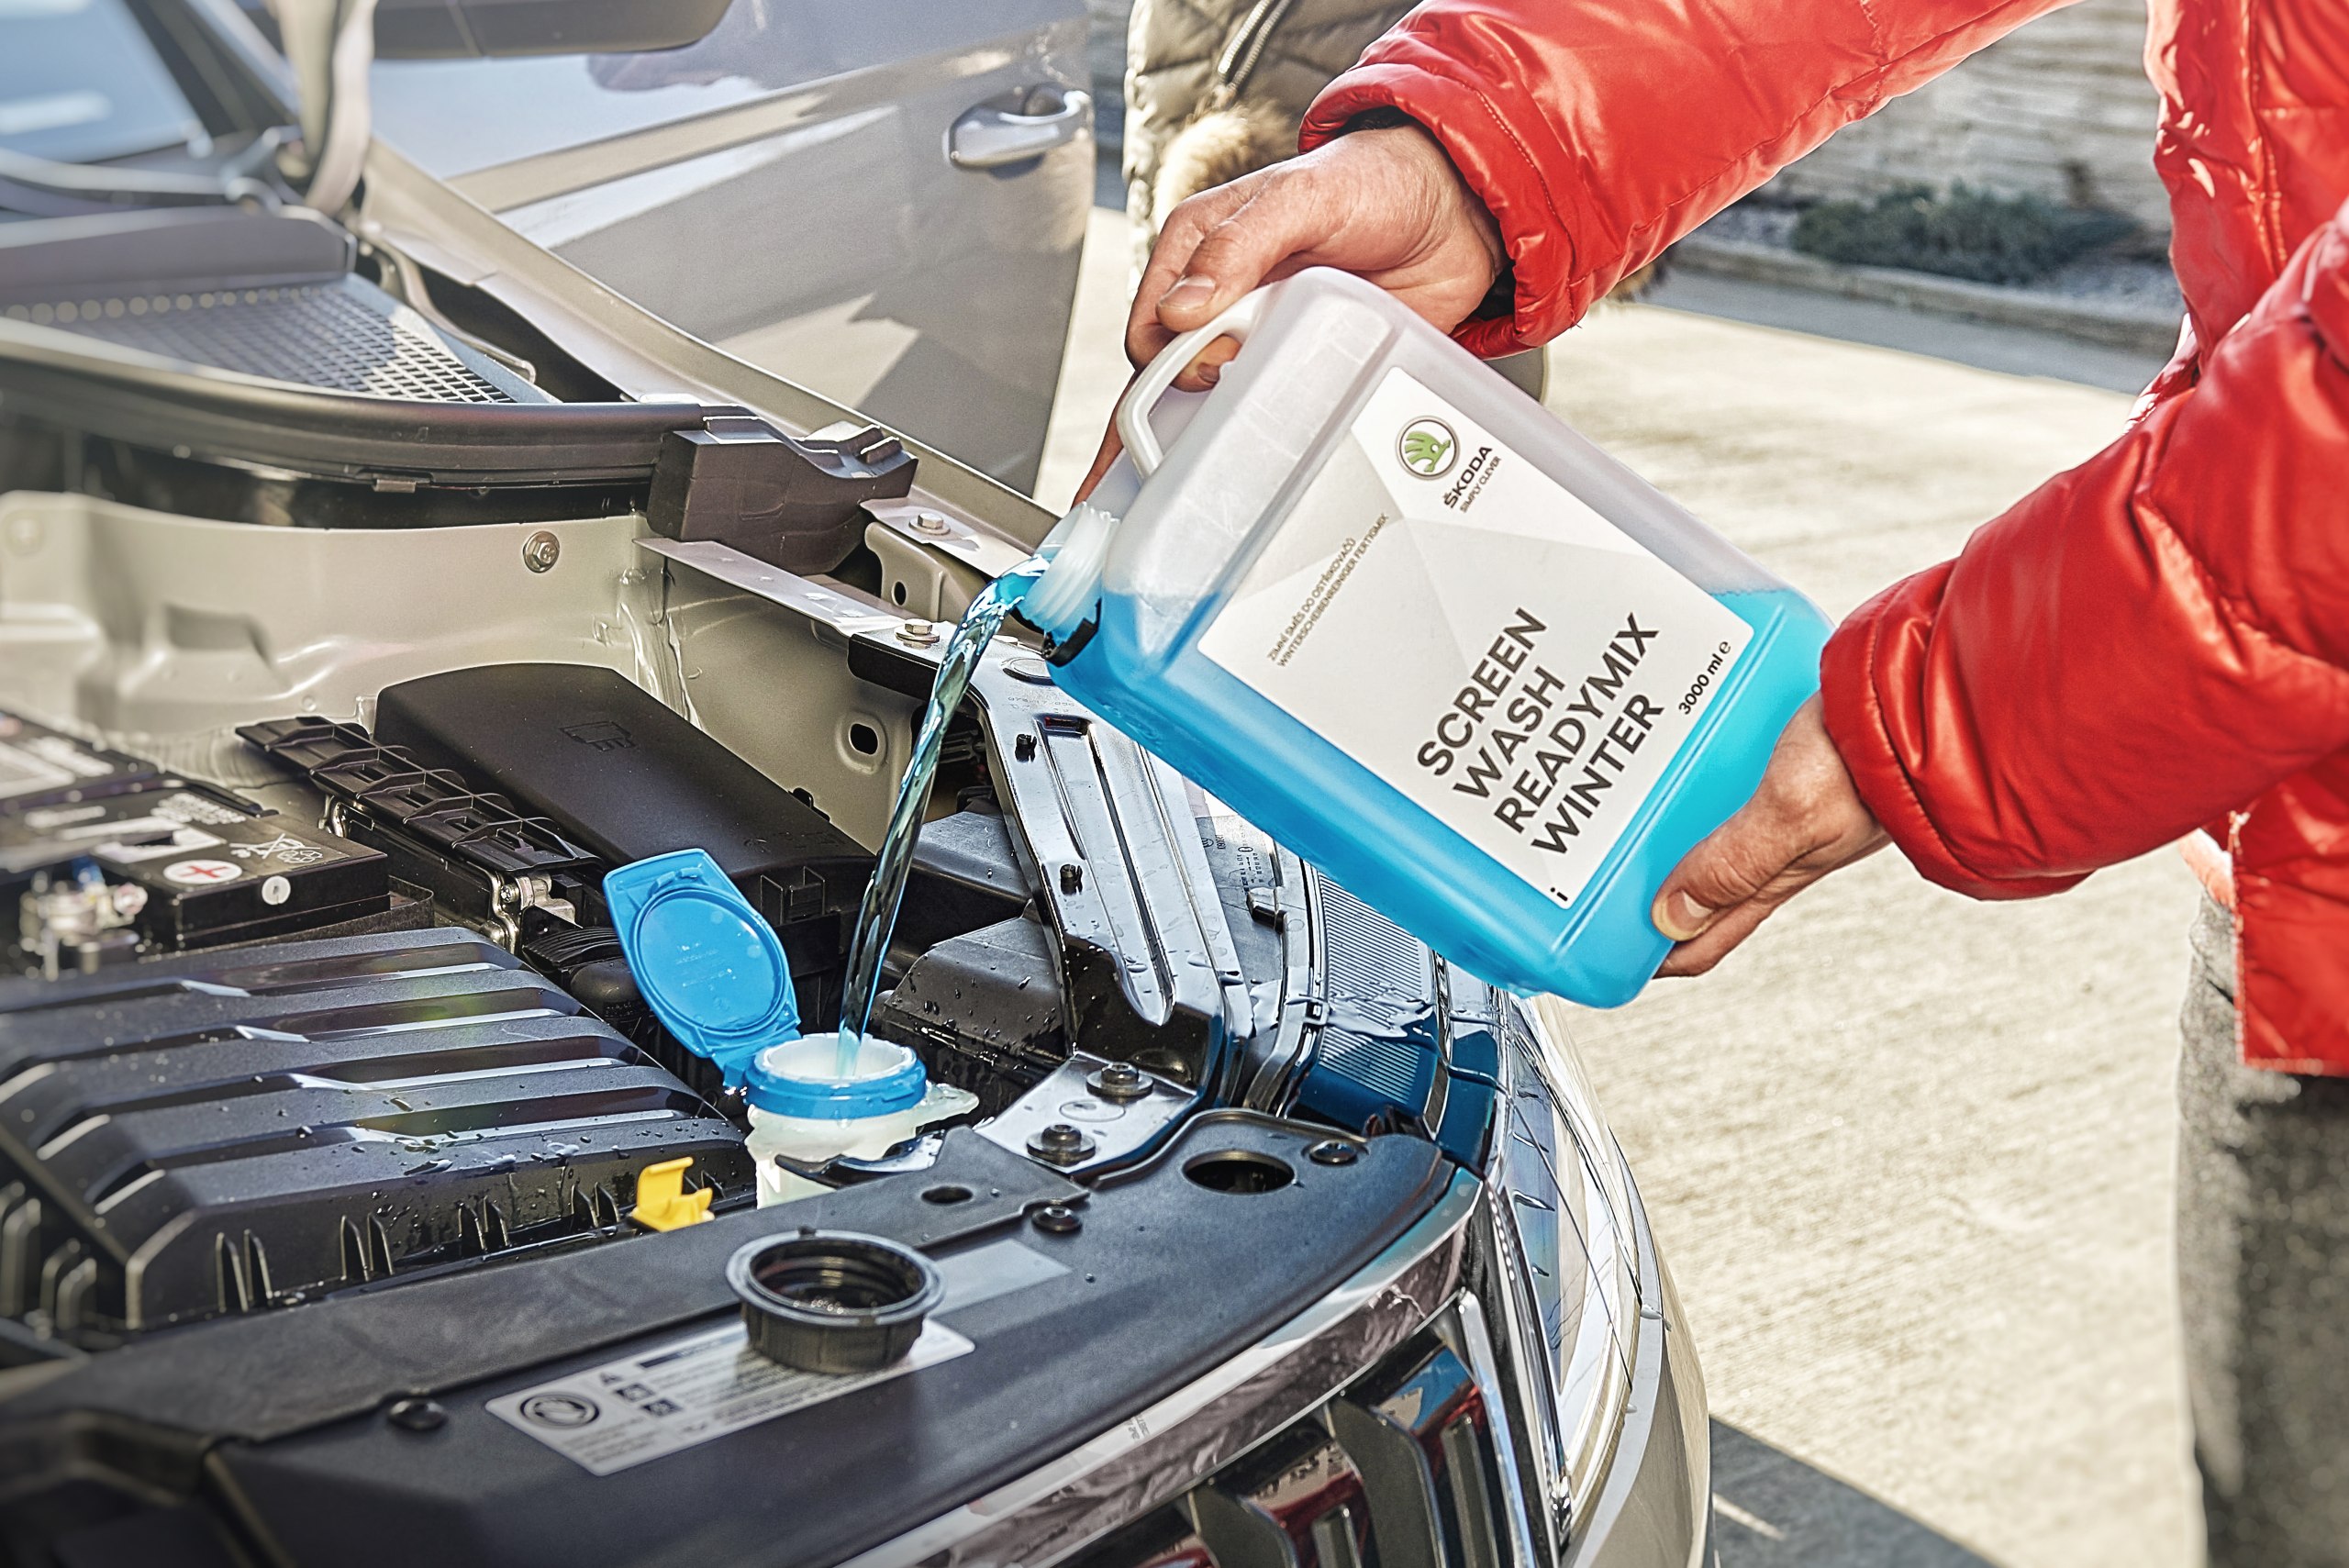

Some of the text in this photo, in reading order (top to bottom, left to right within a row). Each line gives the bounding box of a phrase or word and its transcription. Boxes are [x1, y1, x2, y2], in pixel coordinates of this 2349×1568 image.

[1443, 446, 1493, 508] ŠKODA
[1460, 456, 1501, 513] SIMPLY CLEVER
[1301, 597, 1315, 613] DO
[1417, 607, 1547, 776] SCREEN
[1453, 665, 1566, 799] WASH
[1494, 612, 1659, 834] READYMIX
[1678, 674, 1709, 715] 3000
[1707, 653, 1723, 675] ml
[1531, 694, 1664, 854] WINTER
